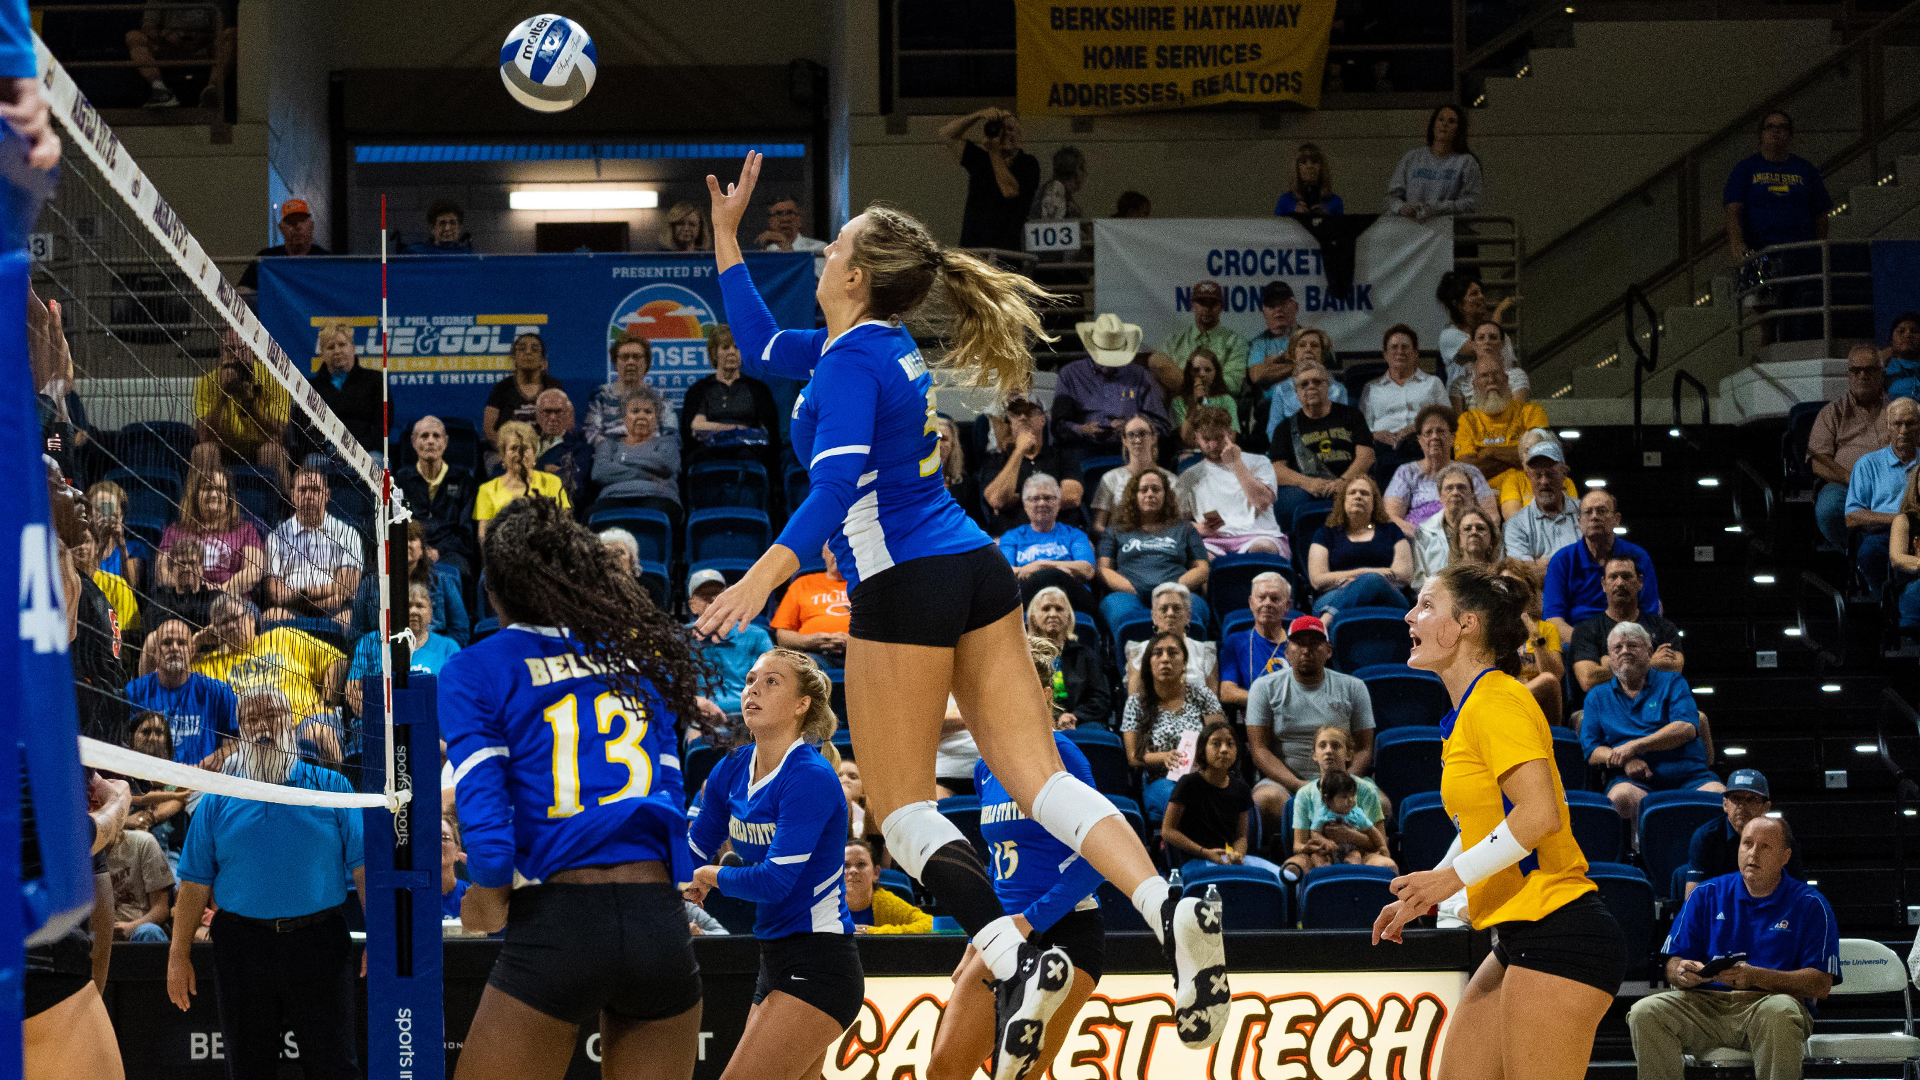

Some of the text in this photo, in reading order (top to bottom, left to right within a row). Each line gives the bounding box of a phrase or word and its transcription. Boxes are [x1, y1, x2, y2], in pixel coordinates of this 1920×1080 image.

[1050, 4, 1301, 31] BERKSHIRE HATHAWAY
[522, 17, 553, 61] molten
[1083, 43, 1262, 69] HOME SERVICES
[1048, 71, 1303, 107] ADDRESSES, REALTORS
[1030, 227, 1073, 247] 103
[612, 266, 713, 278] PRESENTED BY
[1206, 249, 1324, 276] CROCKET
[389, 374, 434, 386] STATE
[543, 693, 652, 818] 13
[993, 840, 1020, 880] 15
[1852, 958, 1889, 966] University
[394, 1007, 416, 1068] sports
[820, 993, 1449, 1080] CAET TECH
